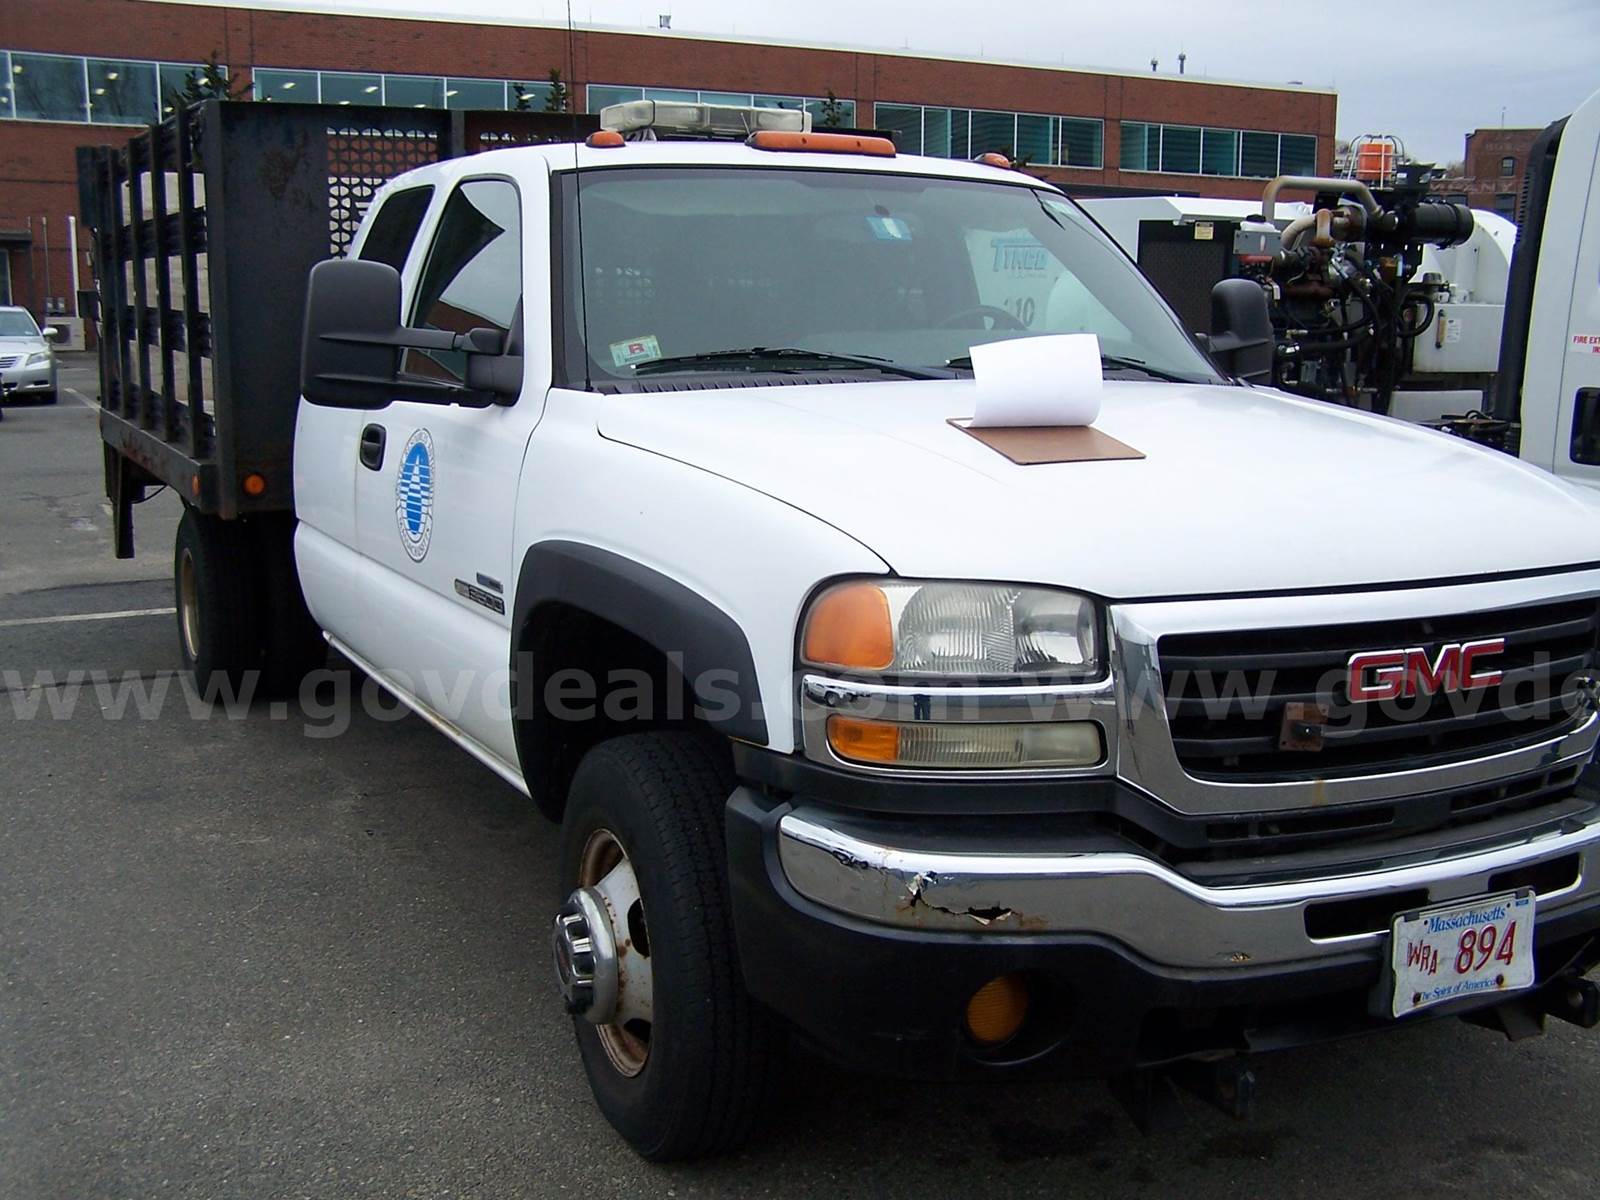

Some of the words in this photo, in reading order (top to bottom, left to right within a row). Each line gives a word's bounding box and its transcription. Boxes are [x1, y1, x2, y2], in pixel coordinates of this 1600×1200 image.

[1348, 637, 1505, 703] GMC
[1407, 940, 1438, 976] WRA
[1455, 919, 1517, 974] 894
[1427, 906, 1505, 933] Massachusetts
